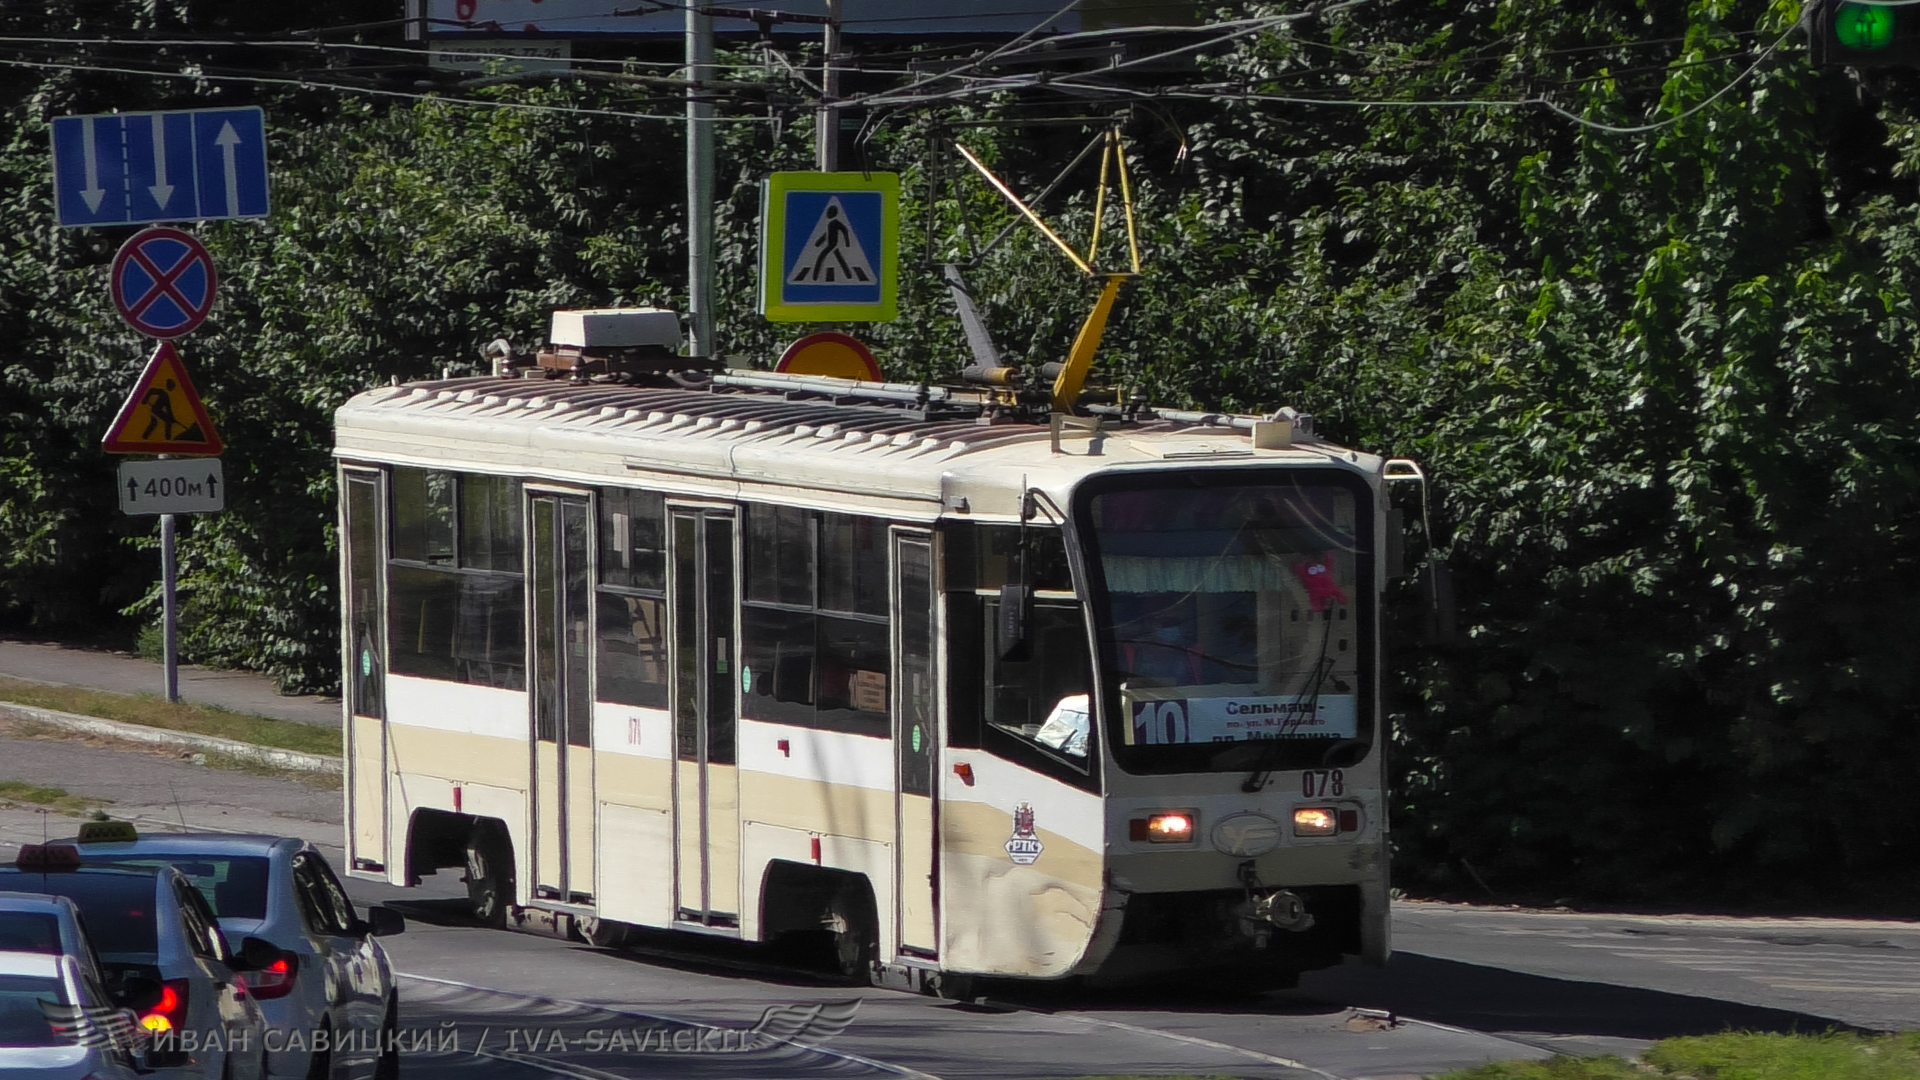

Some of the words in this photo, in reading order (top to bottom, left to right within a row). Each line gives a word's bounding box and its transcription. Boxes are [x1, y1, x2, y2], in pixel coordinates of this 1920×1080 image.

[144, 476, 202, 497] 400м
[1226, 702, 1314, 715] Сельмаш
[1135, 701, 1186, 745] 10
[1302, 769, 1344, 798] 078
